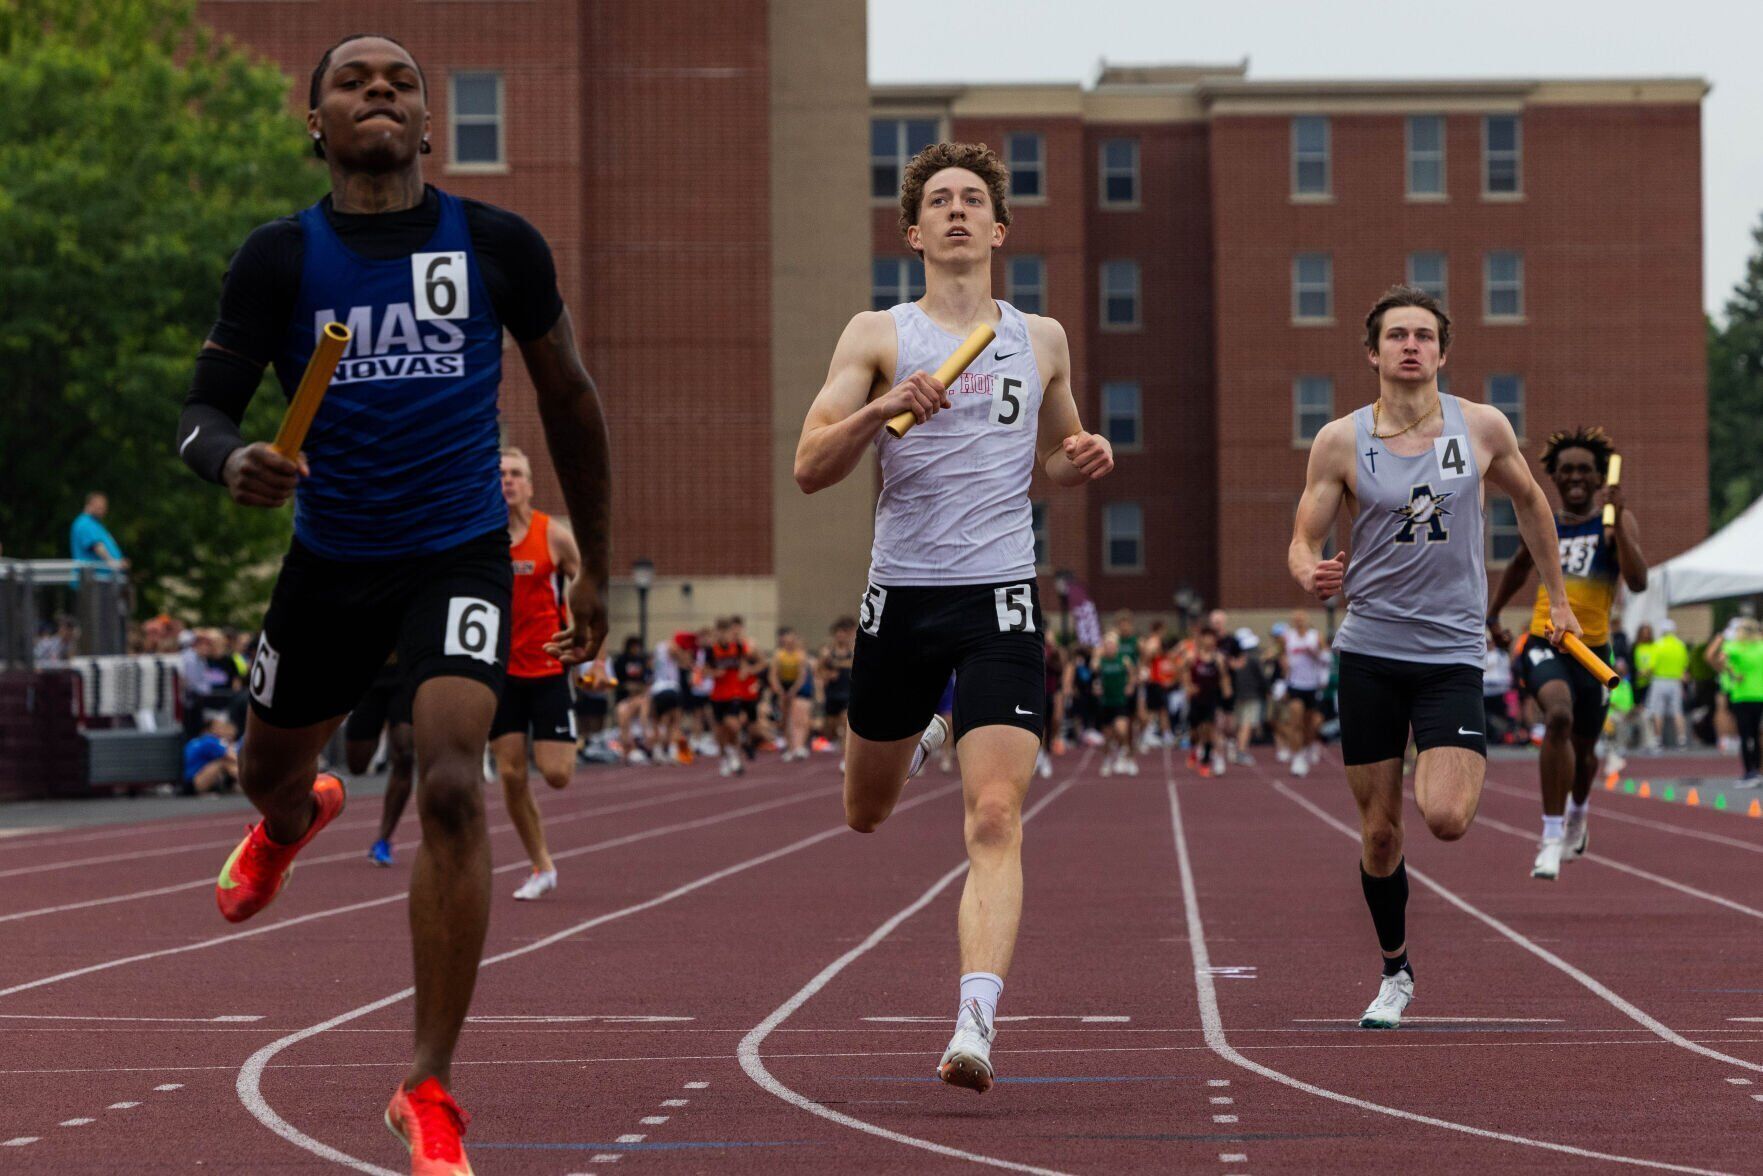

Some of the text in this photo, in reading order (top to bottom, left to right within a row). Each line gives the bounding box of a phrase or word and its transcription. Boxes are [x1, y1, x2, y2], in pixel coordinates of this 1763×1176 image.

[426, 256, 456, 316] 6
[330, 356, 459, 381] NOVAS
[998, 377, 1022, 425] 5
[1442, 438, 1466, 475] 4
[459, 603, 488, 653] 6
[862, 585, 880, 630] 5
[1006, 588, 1027, 631] 5
[253, 643, 269, 697] 6
